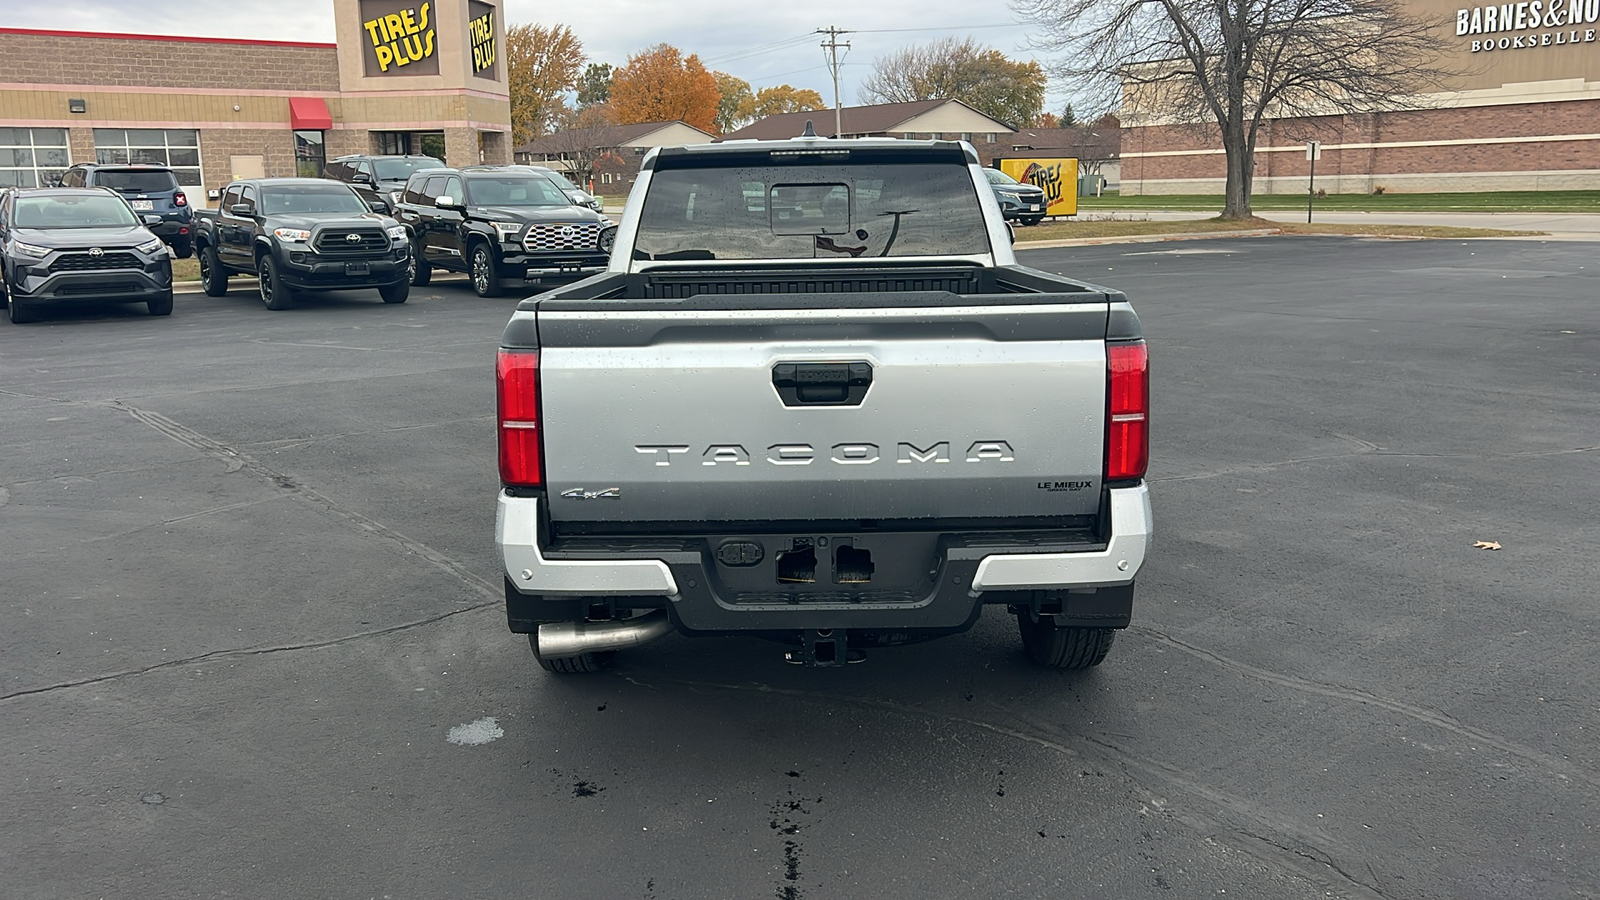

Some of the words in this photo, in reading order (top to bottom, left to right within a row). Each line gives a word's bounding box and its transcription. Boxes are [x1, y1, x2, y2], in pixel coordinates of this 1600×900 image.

[364, 2, 430, 46] TIRES
[469, 12, 493, 46] TIRES
[375, 29, 435, 72] PLUS
[1471, 29, 1600, 53] BOOKSELLE
[474, 38, 496, 73] PLUS
[1029, 162, 1062, 188] TIRES
[1042, 180, 1063, 201] US
[800, 370, 847, 380] TOYOTA
[634, 440, 1014, 466] TACOMA
[1054, 481, 1093, 489] MIEUX
